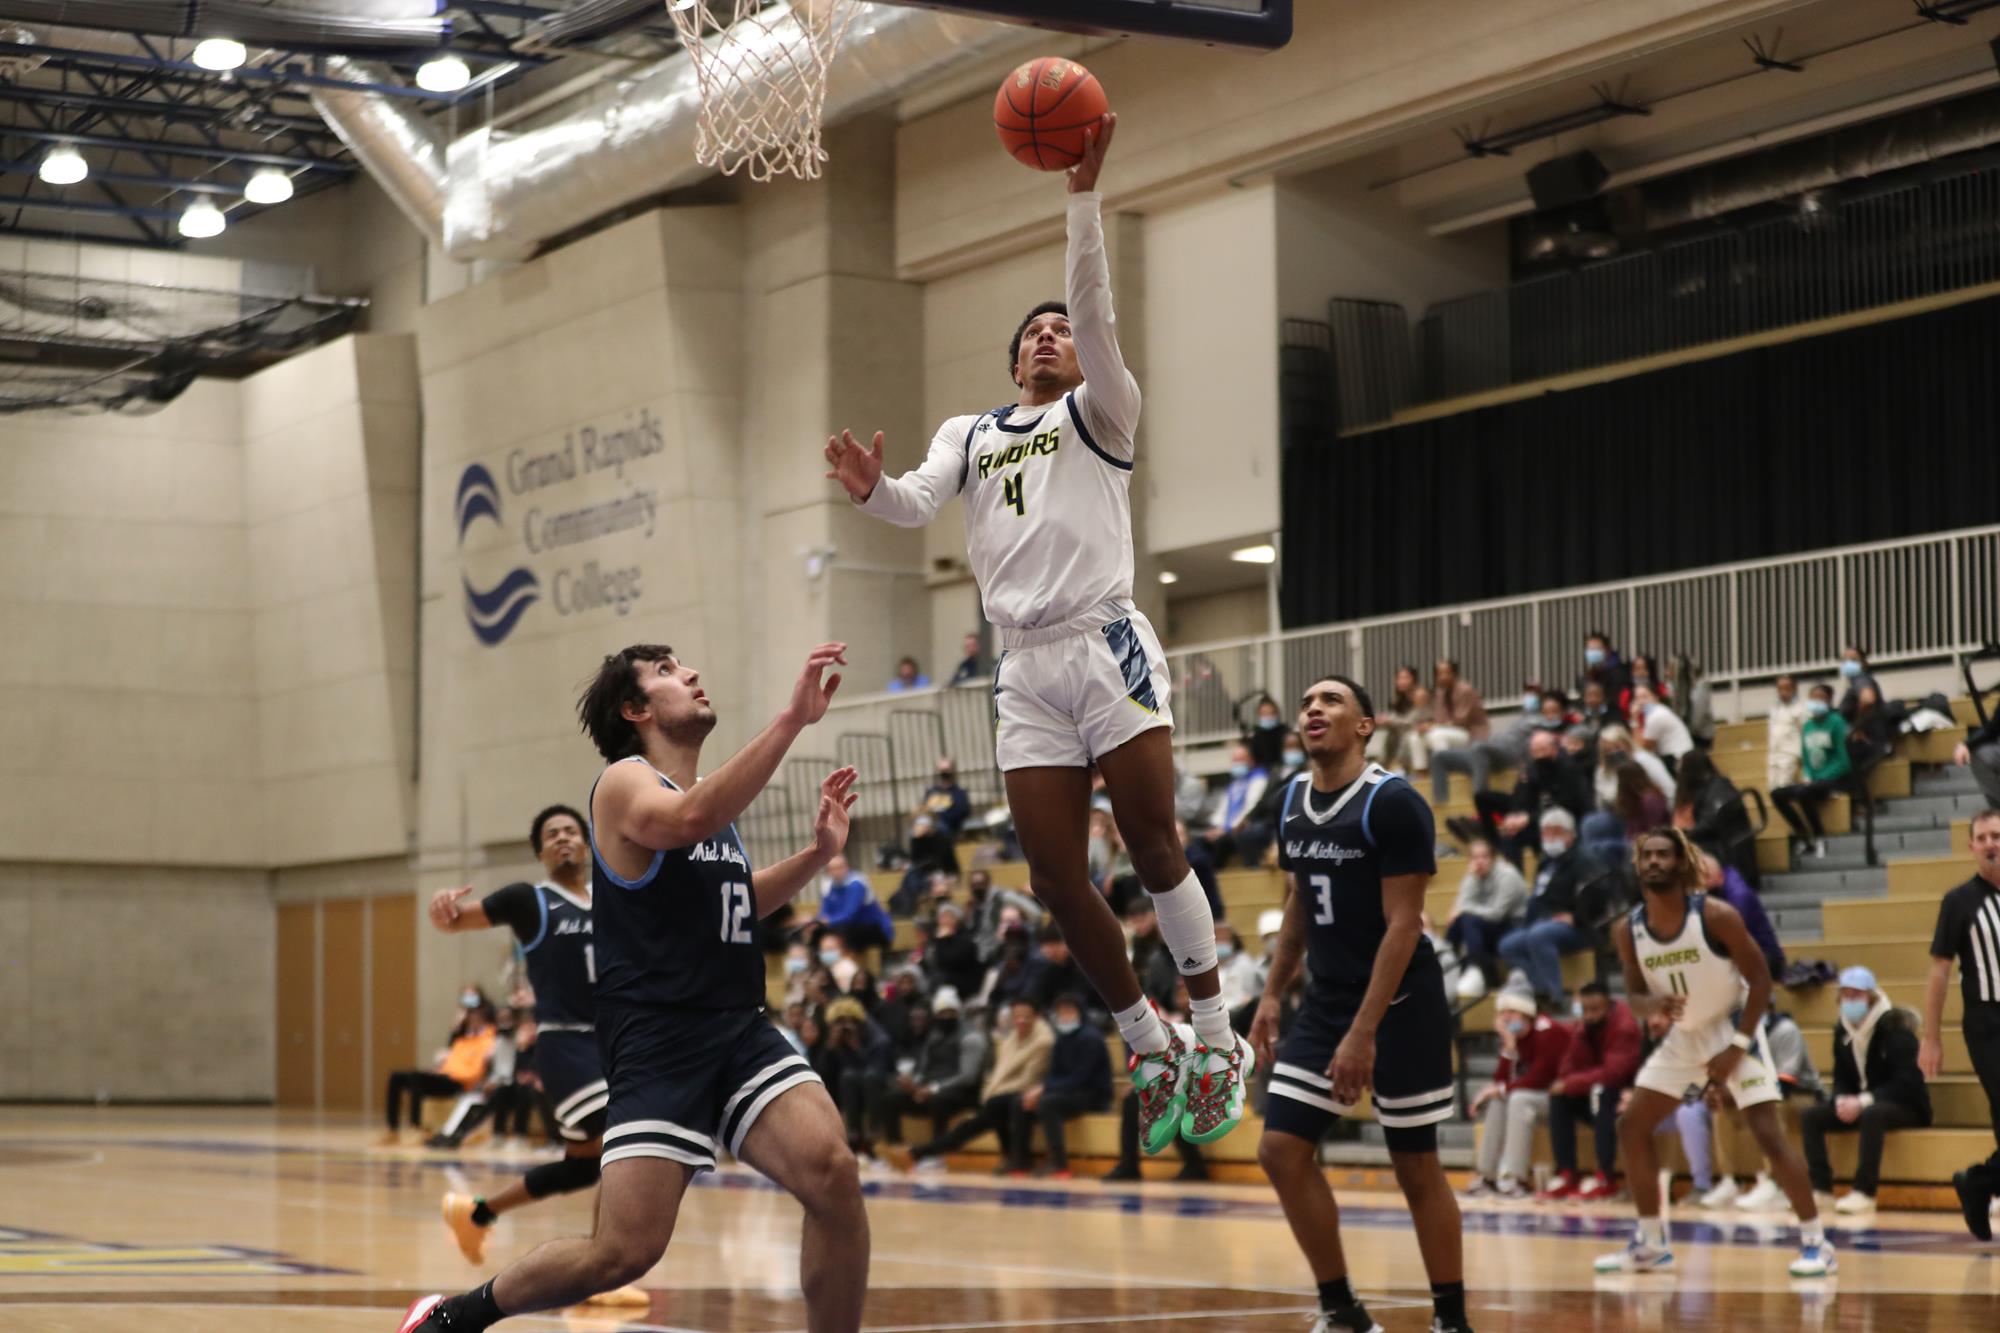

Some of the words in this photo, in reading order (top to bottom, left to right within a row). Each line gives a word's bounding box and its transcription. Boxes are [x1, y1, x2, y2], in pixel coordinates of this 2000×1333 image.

[507, 432, 576, 495] Grand
[580, 408, 664, 480] Rapids
[1004, 471, 1024, 516] 4
[524, 484, 656, 554] Community
[553, 561, 642, 616] College
[688, 841, 719, 862] Mid
[1303, 840, 1365, 866] Michigan
[721, 881, 752, 944] 12
[1310, 874, 1335, 925] 3
[1645, 948, 1701, 969] RAIDERS
[1669, 972, 1688, 995] 11
